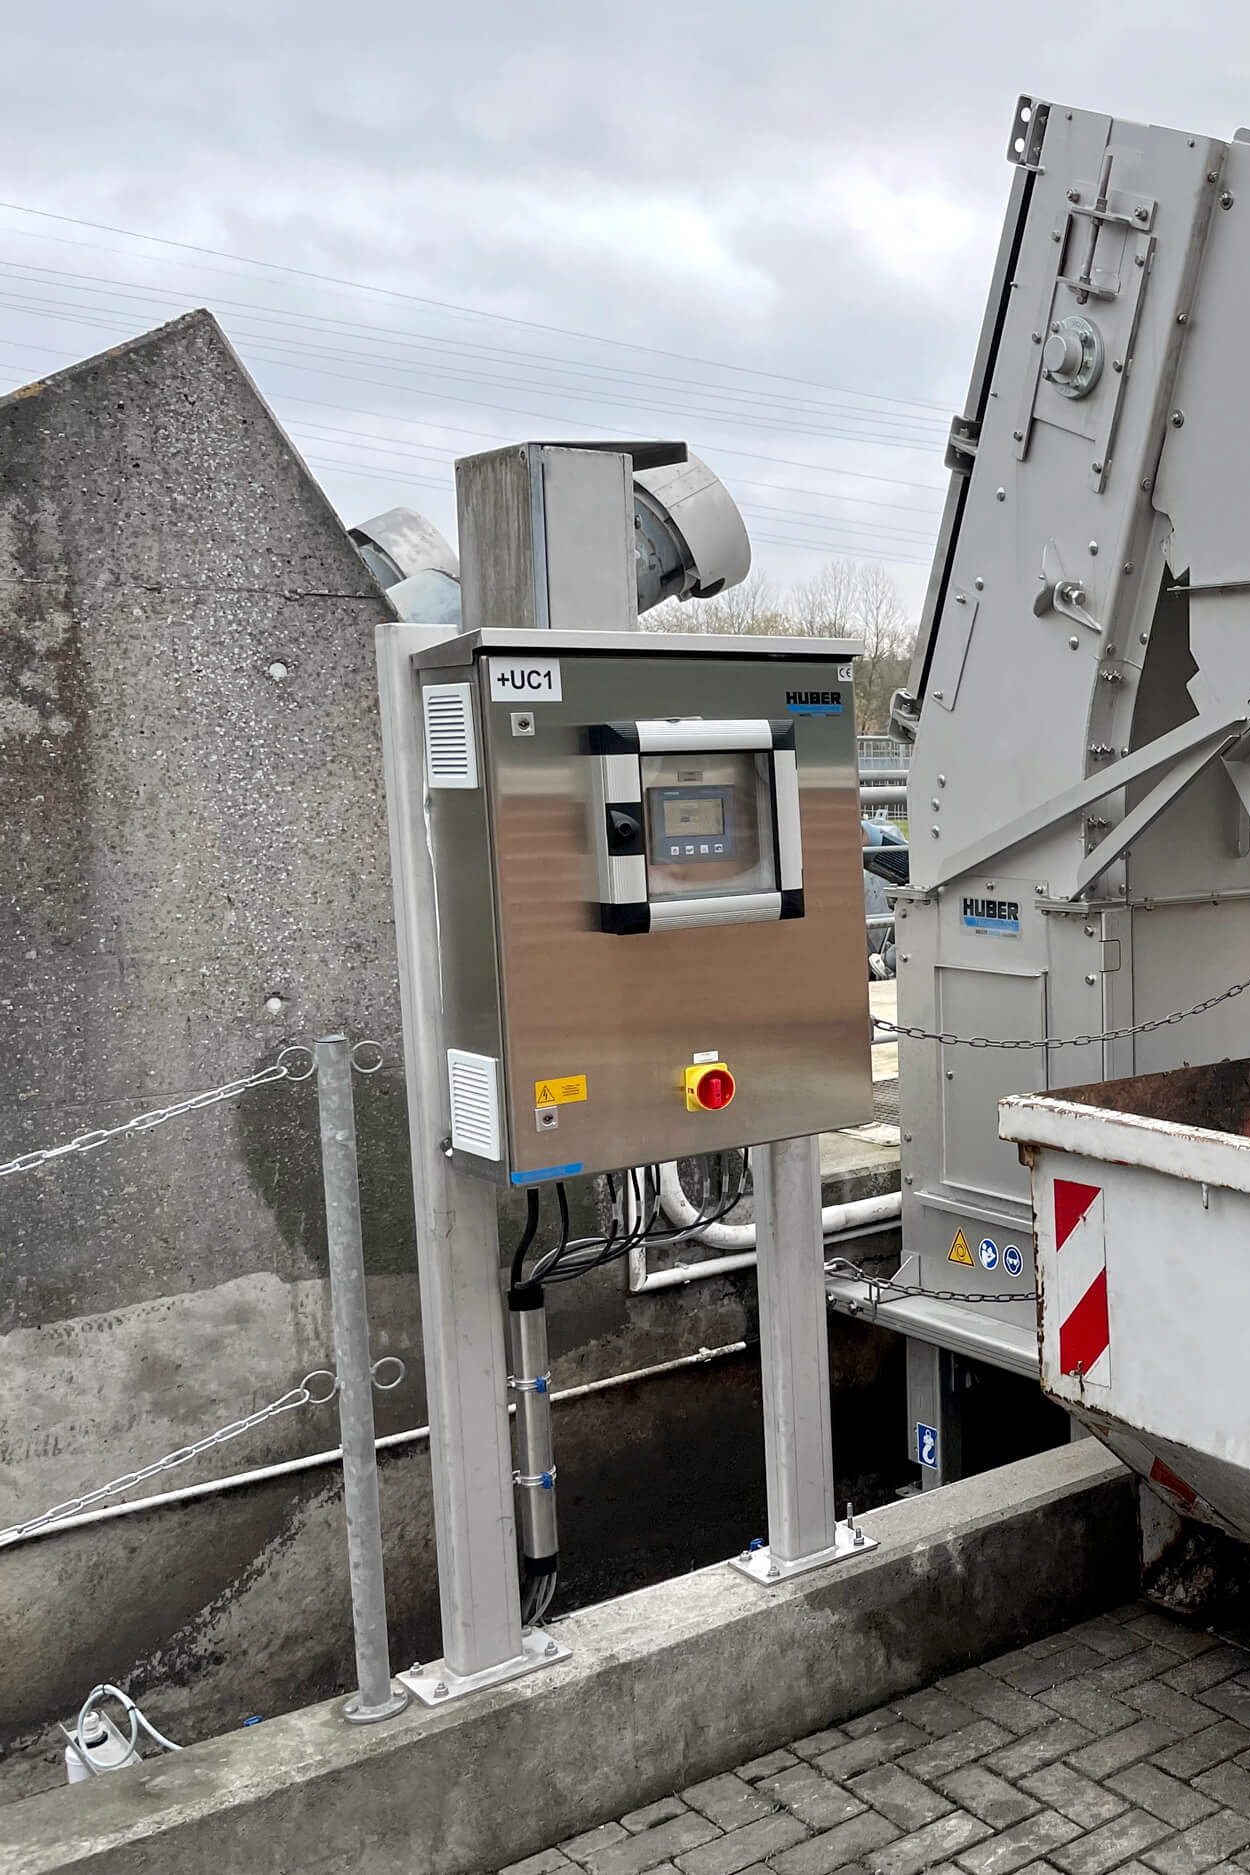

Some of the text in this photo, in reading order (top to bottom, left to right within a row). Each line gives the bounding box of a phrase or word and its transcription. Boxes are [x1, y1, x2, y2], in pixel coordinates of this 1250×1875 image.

[497, 670, 552, 690] +UC1
[785, 691, 842, 705] HUBER
[963, 898, 1019, 921] HUBER
